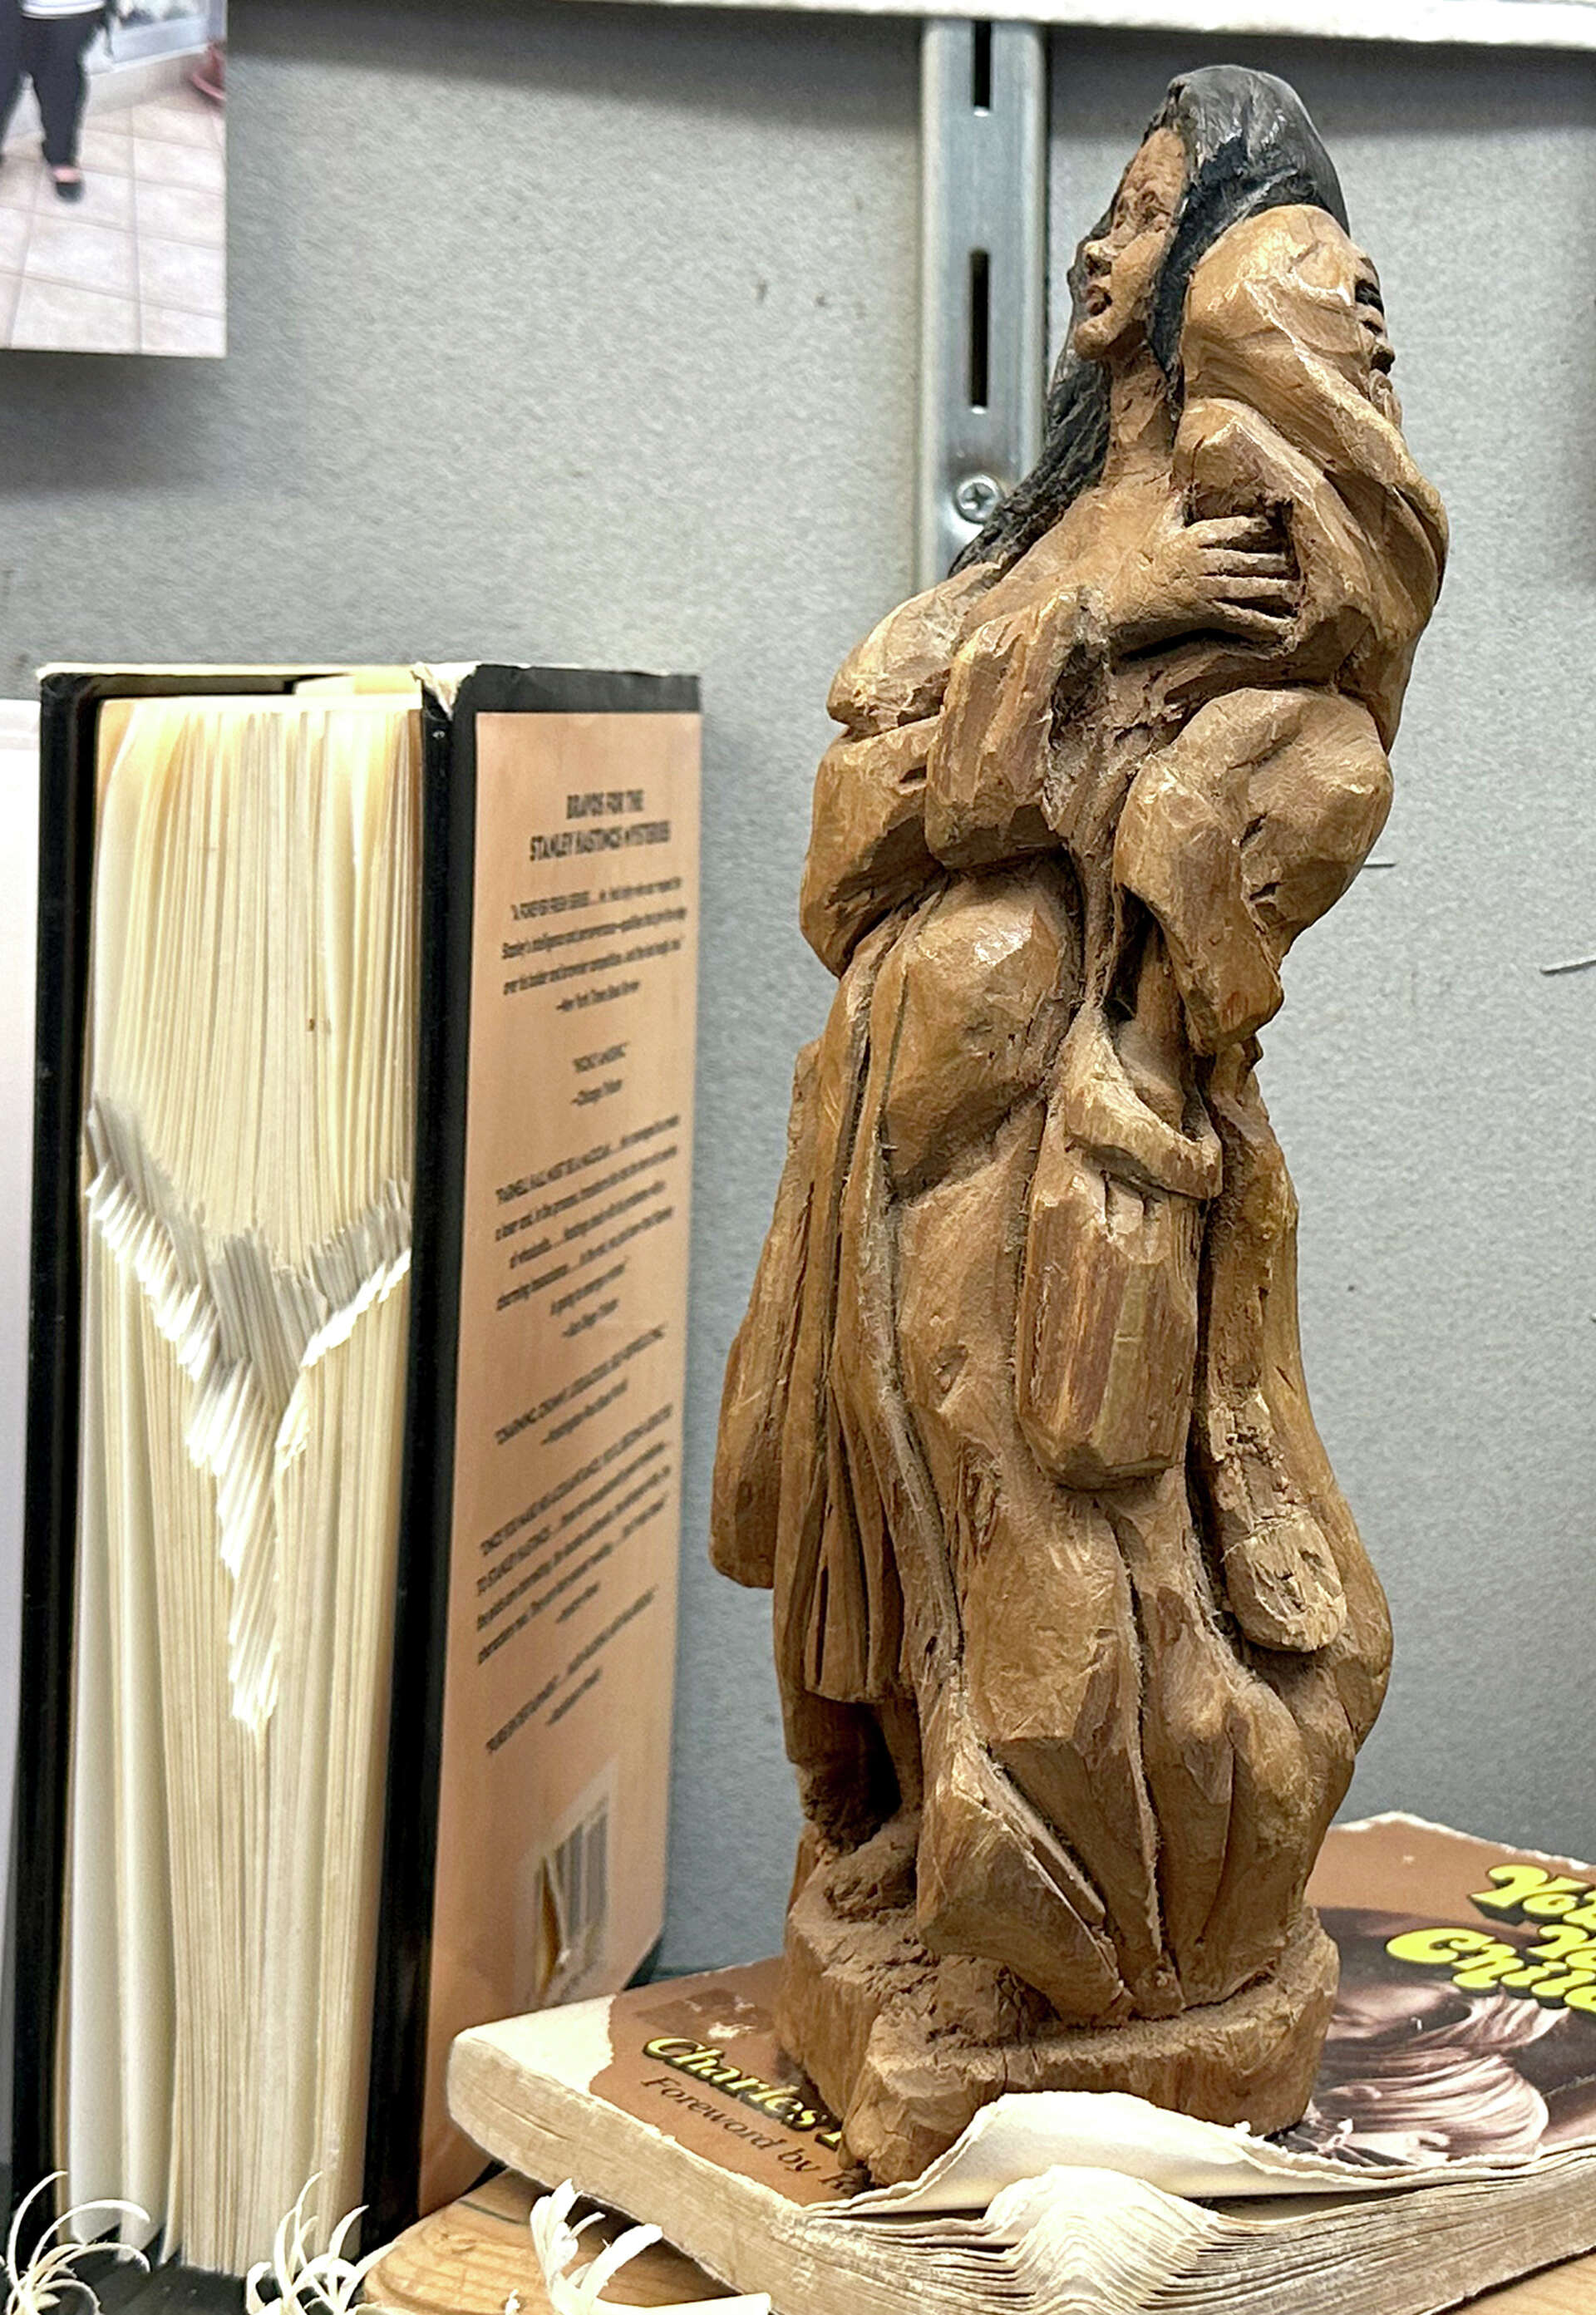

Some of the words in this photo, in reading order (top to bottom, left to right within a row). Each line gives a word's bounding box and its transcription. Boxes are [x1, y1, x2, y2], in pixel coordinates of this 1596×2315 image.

[641, 2076, 786, 2151] Foreword
[778, 2147, 822, 2175] by
[643, 2037, 819, 2131] Charles
